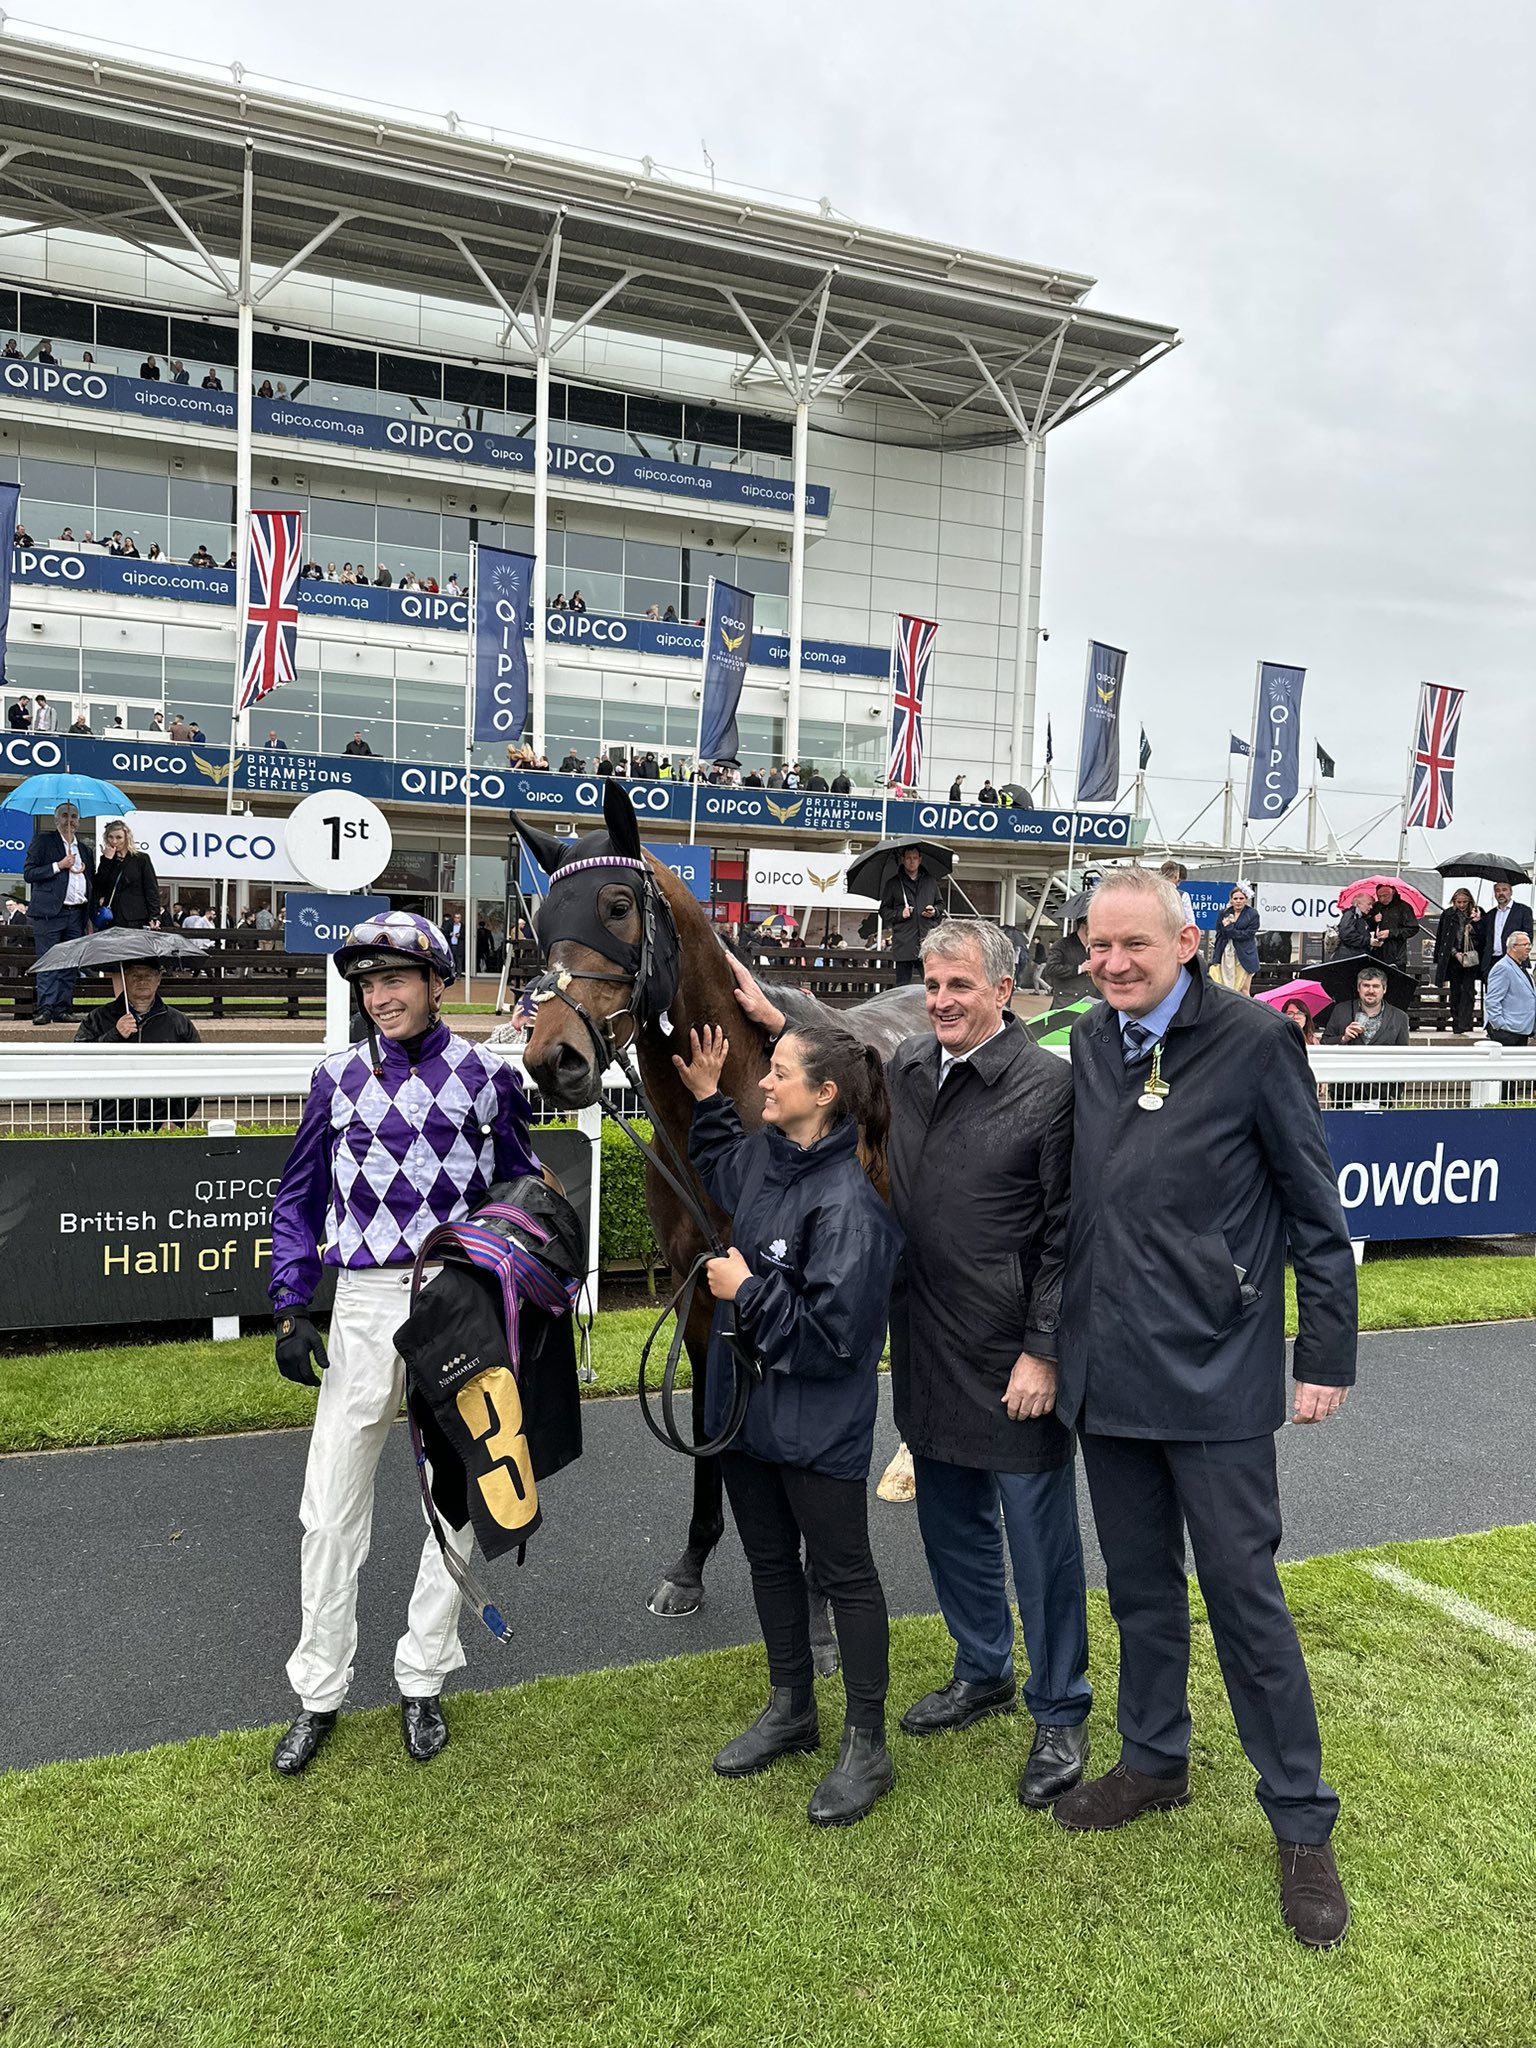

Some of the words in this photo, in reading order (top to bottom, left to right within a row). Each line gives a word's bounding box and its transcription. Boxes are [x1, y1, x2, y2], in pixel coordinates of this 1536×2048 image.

[5, 364, 108, 400] QIPCO
[135, 390, 234, 417] qipco.com.qa
[271, 410, 365, 436] qipco.com.qa
[386, 422, 474, 454] QIPCO
[491, 449, 524, 462] QIPCO
[634, 466, 712, 490] qipco.com.qa
[12, 550, 86, 581] IPCO
[122, 569, 229, 594] qipco.com.qa
[401, 596, 468, 623] QIPC
[547, 613, 627, 642] QIPCO
[492, 599, 516, 731] QIPCO
[769, 646, 846, 665] qip.com.qa
[112, 753, 187, 774] QIPCO
[247, 754, 317, 768] BRITISH
[1263, 704, 1289, 811] QIPCO
[247, 765, 352, 784] CHAMPIONS
[247, 778, 309, 791] SERIES
[401, 768, 505, 799] QIPCO
[526, 791, 563, 803] QIPCO
[575, 782, 670, 811] QICO
[706, 798, 762, 816] QIPCO
[806, 797, 858, 809] BRITISH
[804, 818, 851, 829] SERIES
[805, 807, 883, 822] CHAMPIONS
[919, 806, 998, 832] QIPCO
[1052, 815, 1127, 839] QIPCO
[322, 816, 370, 861] 1st
[1013, 824, 1043, 834] QIPCO
[159, 831, 276, 860] QIPCO
[1291, 898, 1340, 918] QIPC
[314, 924, 351, 940] QIP
[1337, 1142, 1500, 1209] owden
[59, 1210, 157, 1234] British
[168, 1206, 273, 1231] Champi
[104, 1241, 181, 1276] Hall
[198, 1239, 237, 1272] of
[456, 1366, 538, 1530] 3
